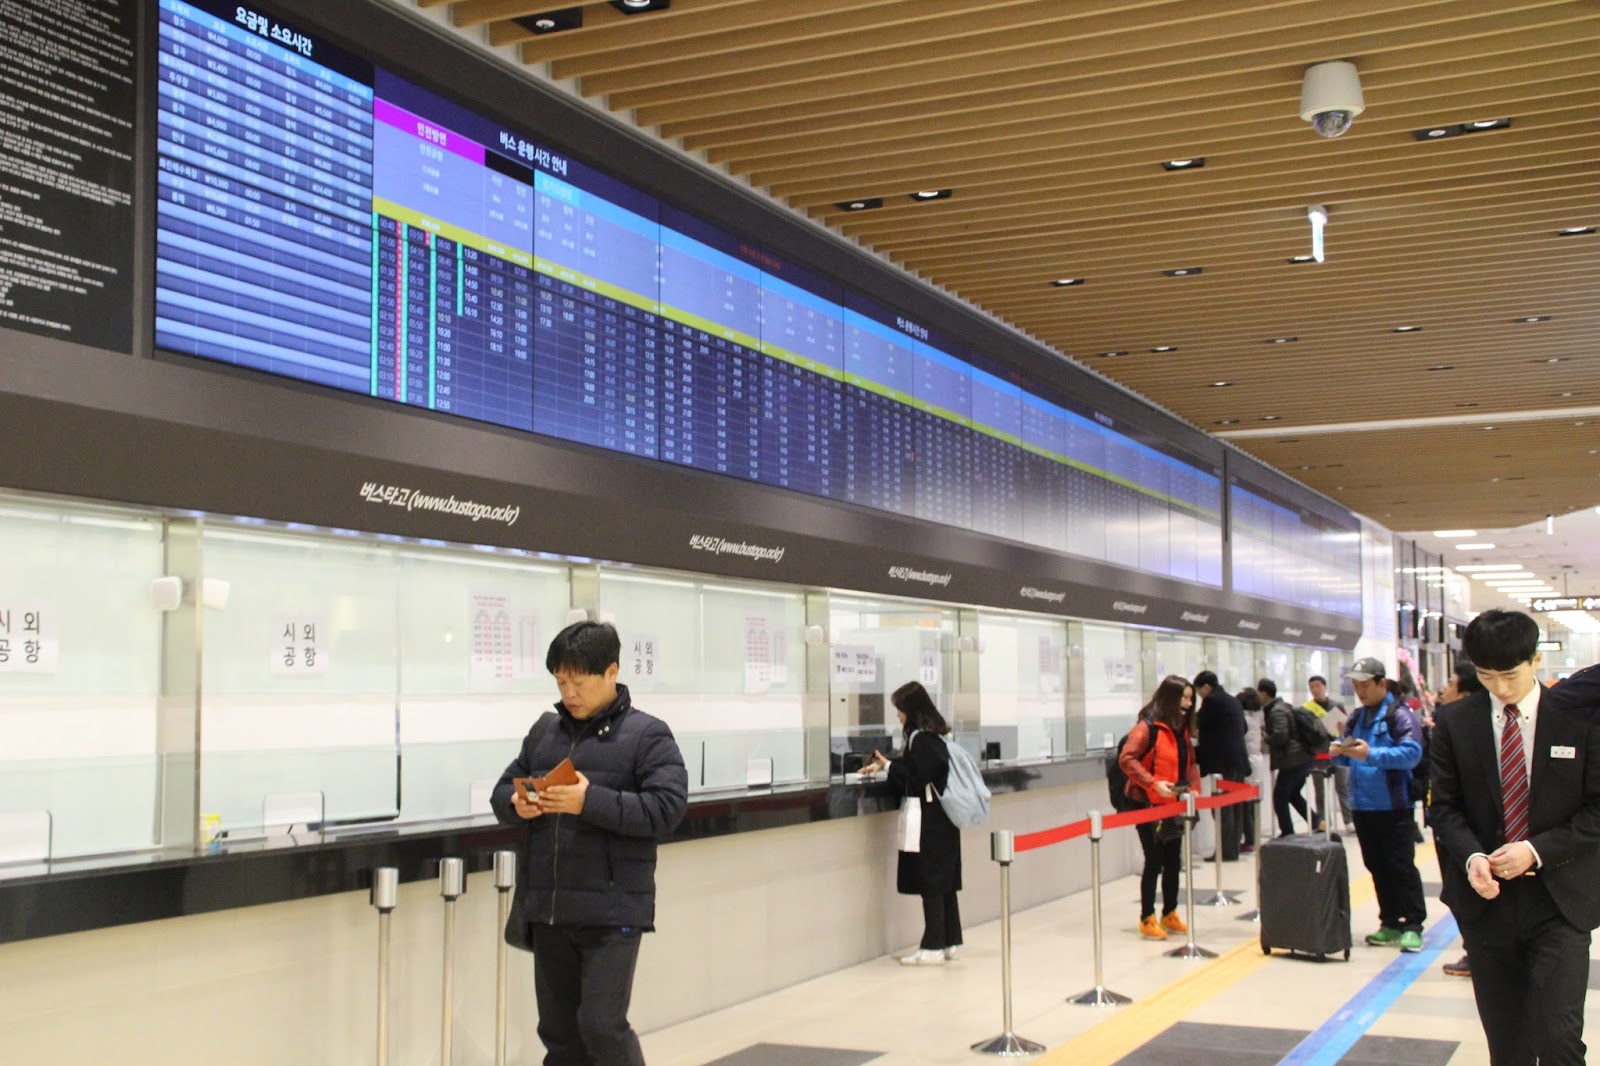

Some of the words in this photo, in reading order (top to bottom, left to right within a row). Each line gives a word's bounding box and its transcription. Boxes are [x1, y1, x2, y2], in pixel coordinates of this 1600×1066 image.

[235, 6, 268, 37] 요금및
[270, 24, 313, 56] 소요시간
[500, 131, 516, 151] 버스
[552, 156, 568, 176] 안내
[464, 248, 478, 260] 13:20
[437, 384, 450, 395] 12:40
